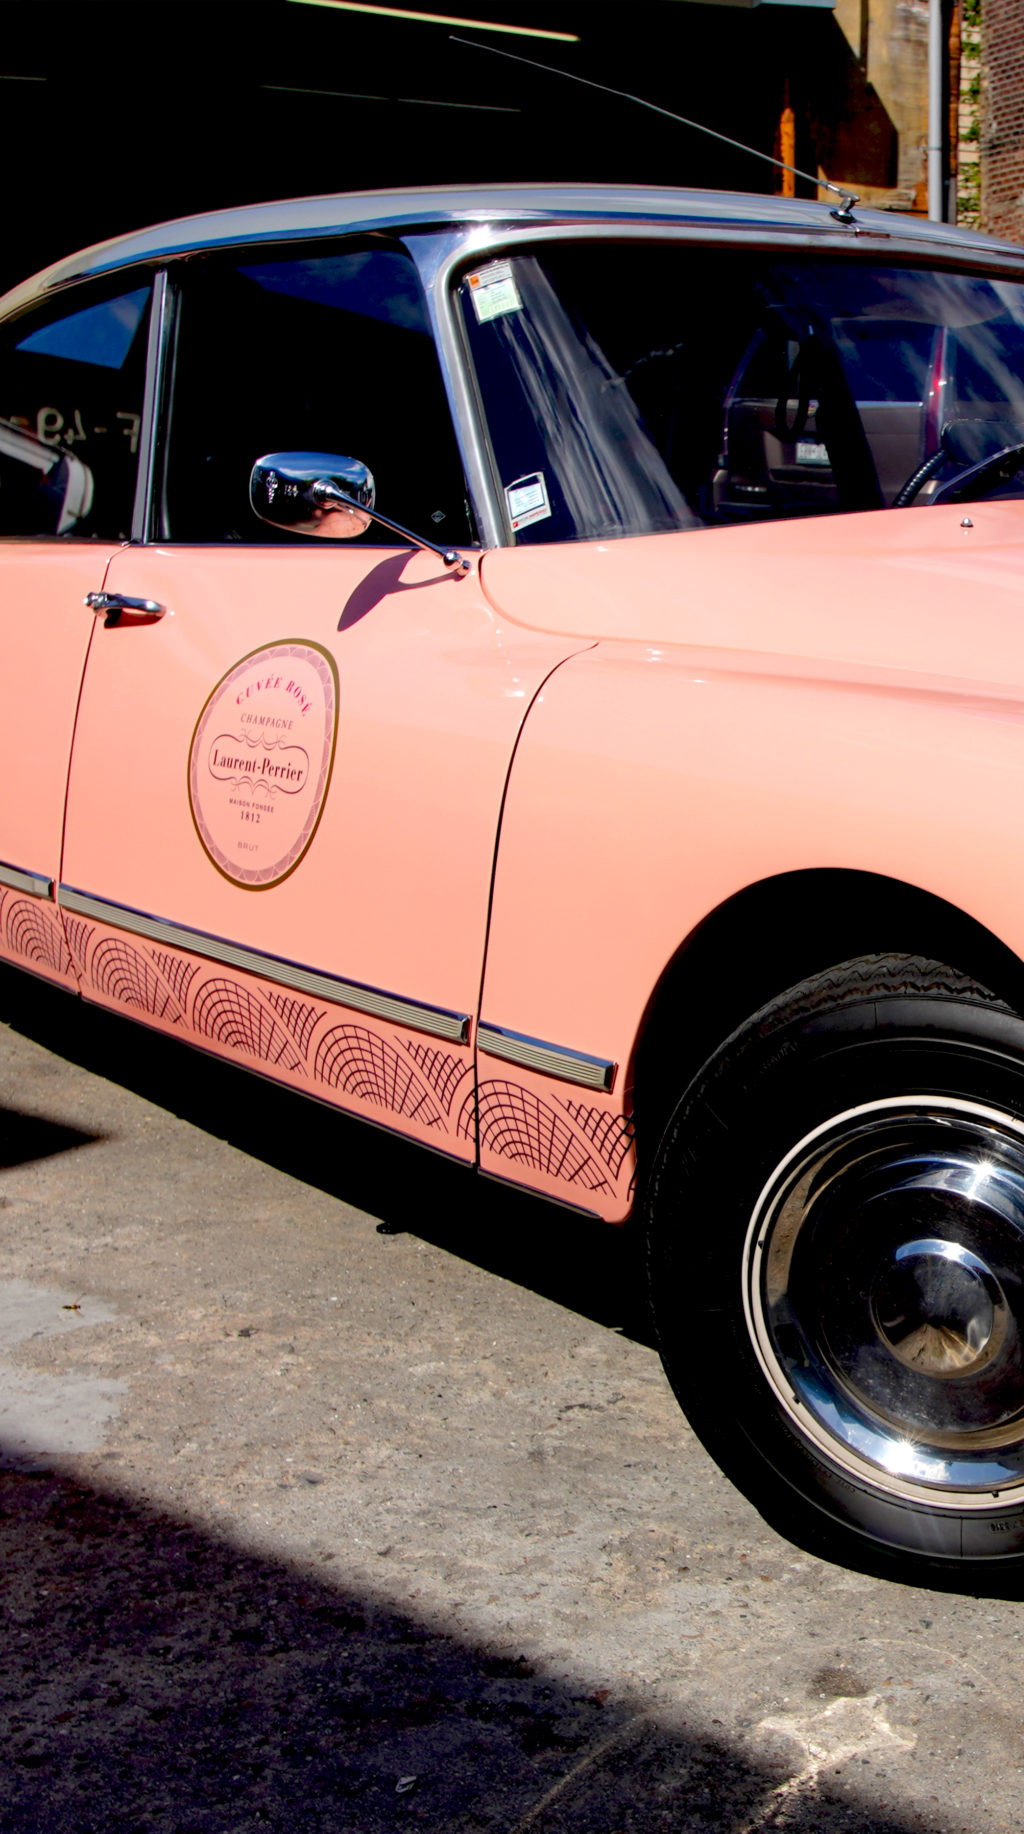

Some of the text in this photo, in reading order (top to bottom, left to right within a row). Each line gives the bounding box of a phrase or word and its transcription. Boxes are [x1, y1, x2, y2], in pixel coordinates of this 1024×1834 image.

[236, 673, 313, 718] CUVÉE ROSÉ
[240, 712, 295, 731] CHAMPAGNE
[212, 748, 304, 782] Laurent-Perrier
[229, 797, 250, 809] MAISON
[240, 809, 261, 824] 1812
[237, 841, 260, 853] BRUT
